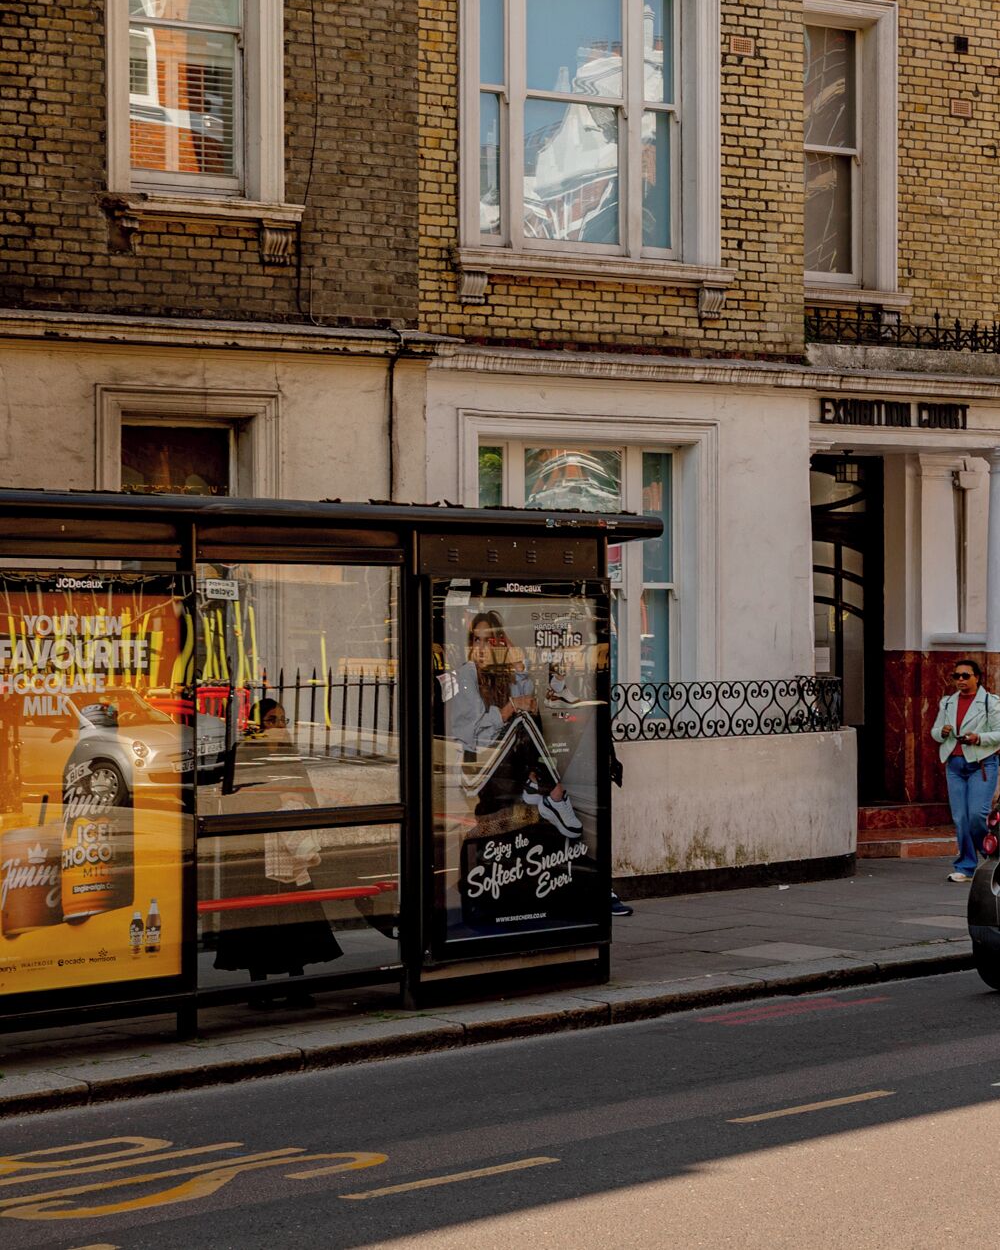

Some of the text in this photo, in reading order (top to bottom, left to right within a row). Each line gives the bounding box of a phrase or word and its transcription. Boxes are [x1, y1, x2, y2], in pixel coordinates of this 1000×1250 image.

[820, 397, 970, 430] EXHIBITION COURT
[56, 578, 103, 590] JCDecaux
[504, 582, 542, 594] JCDecaux
[24, 615, 124, 637] YOUR NEW
[0, 639, 149, 670] FAVOURITE
[23, 695, 71, 717] MILK
[483, 833, 529, 861] Enjoy the
[467, 836, 588, 899] Softest Sneaker
[535, 861, 573, 898] Ever!
